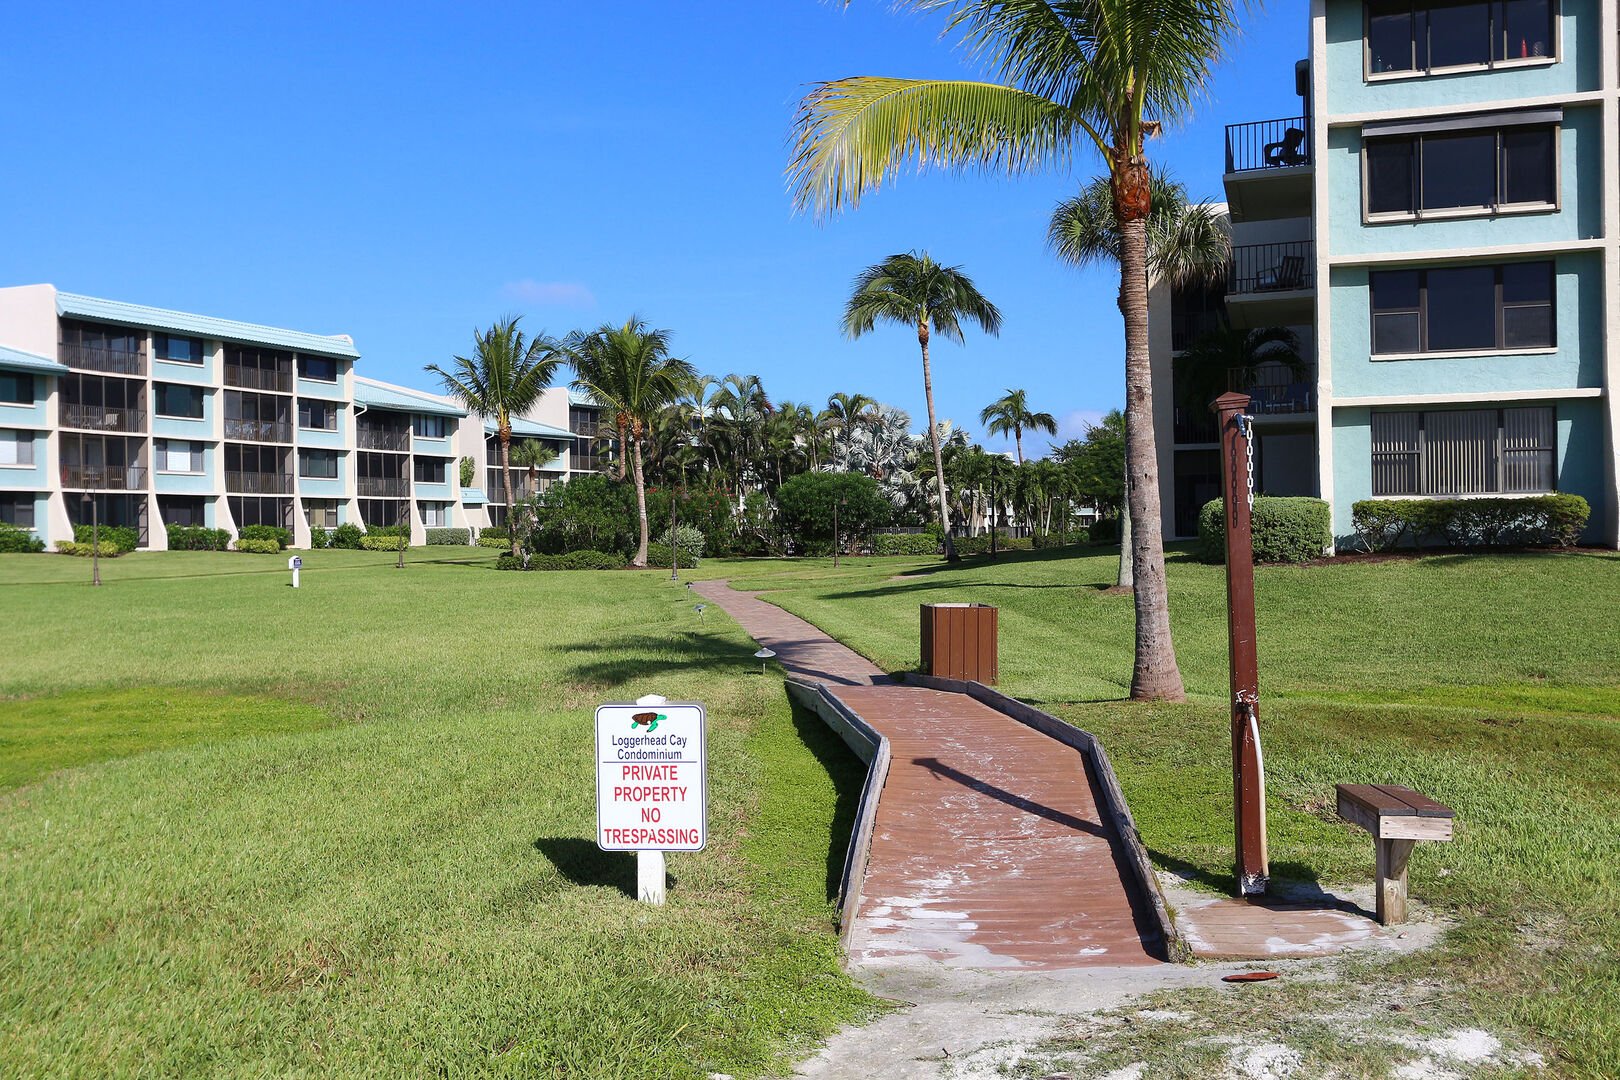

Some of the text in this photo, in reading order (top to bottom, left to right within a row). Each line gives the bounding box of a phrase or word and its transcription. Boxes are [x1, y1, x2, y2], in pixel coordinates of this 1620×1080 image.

[612, 734, 687, 749] Loggerhead Cay
[617, 748, 682, 760] Condominium
[622, 765, 678, 781] PRIVATE
[614, 786, 688, 802] PROPERTY
[641, 807, 661, 823] NO
[604, 828, 699, 844] TRESPASSING
